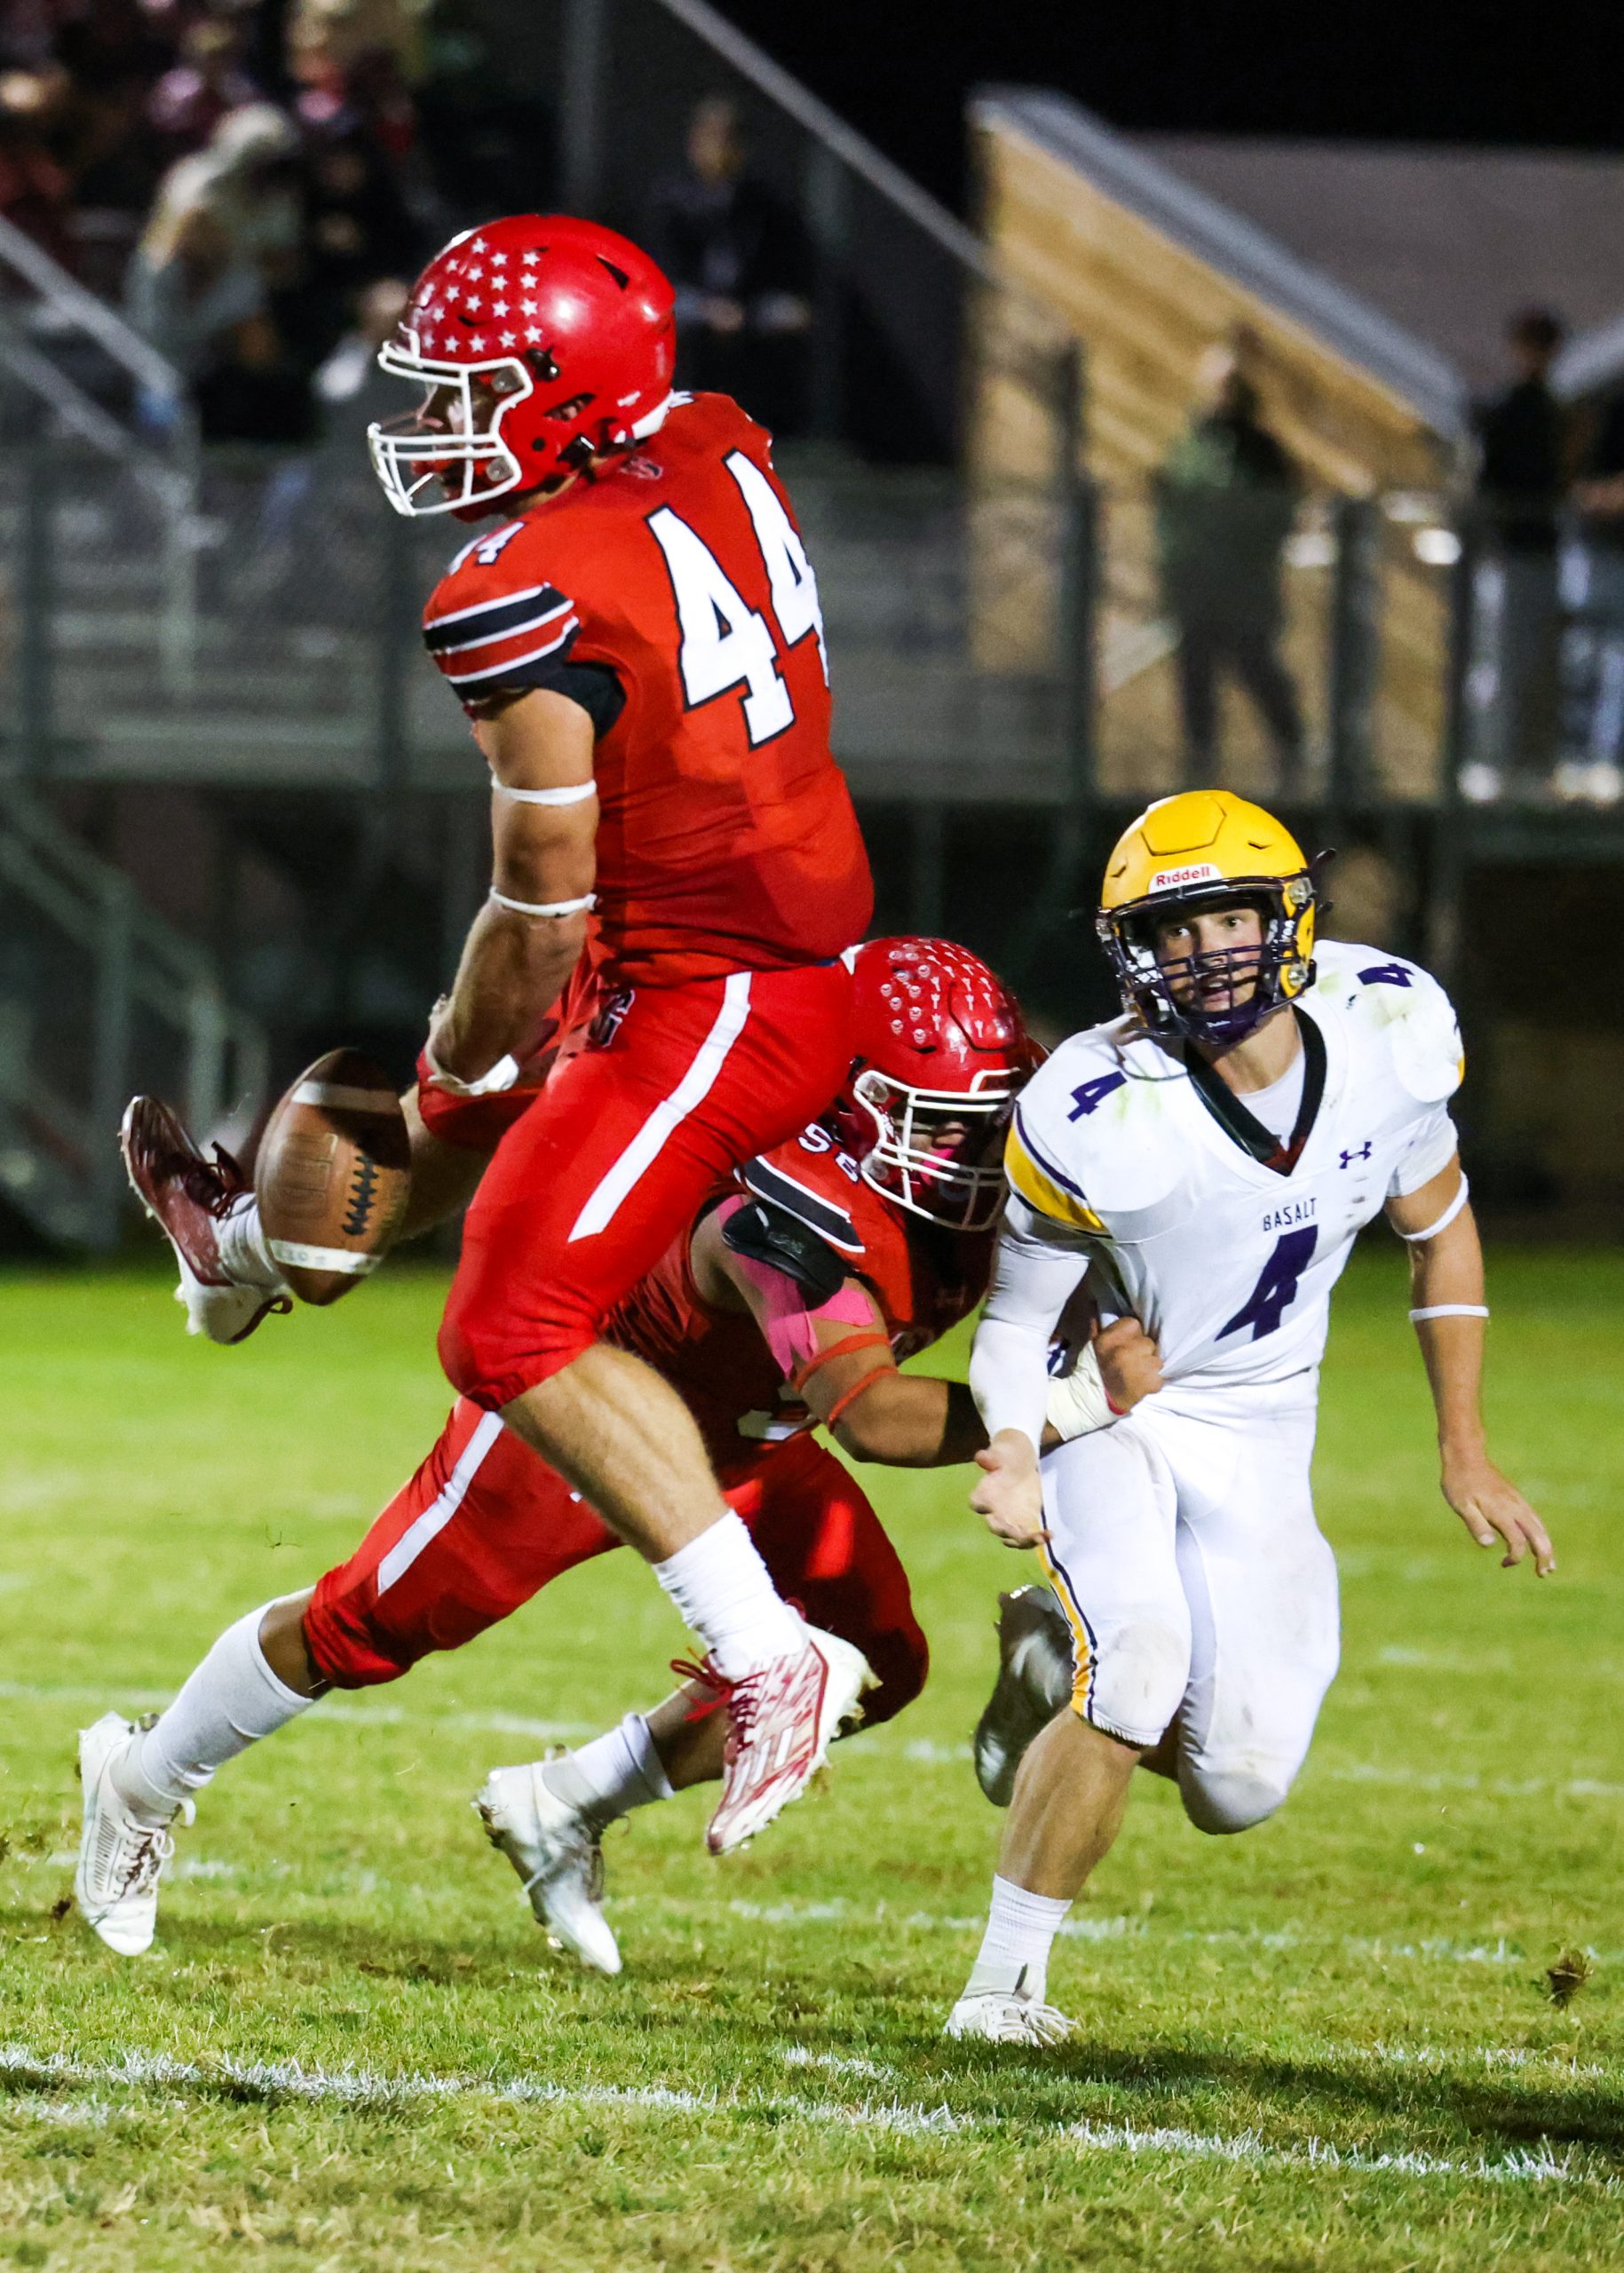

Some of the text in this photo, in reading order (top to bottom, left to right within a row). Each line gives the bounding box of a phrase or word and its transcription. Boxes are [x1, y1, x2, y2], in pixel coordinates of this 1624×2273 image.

[643, 446, 830, 753] 44
[1156, 866, 1210, 886] Riddell
[1356, 962, 1415, 988] 4
[1066, 1070, 1128, 1123] 4
[1263, 1197, 1317, 1232] BASALT
[1214, 1224, 1319, 1342] 4
